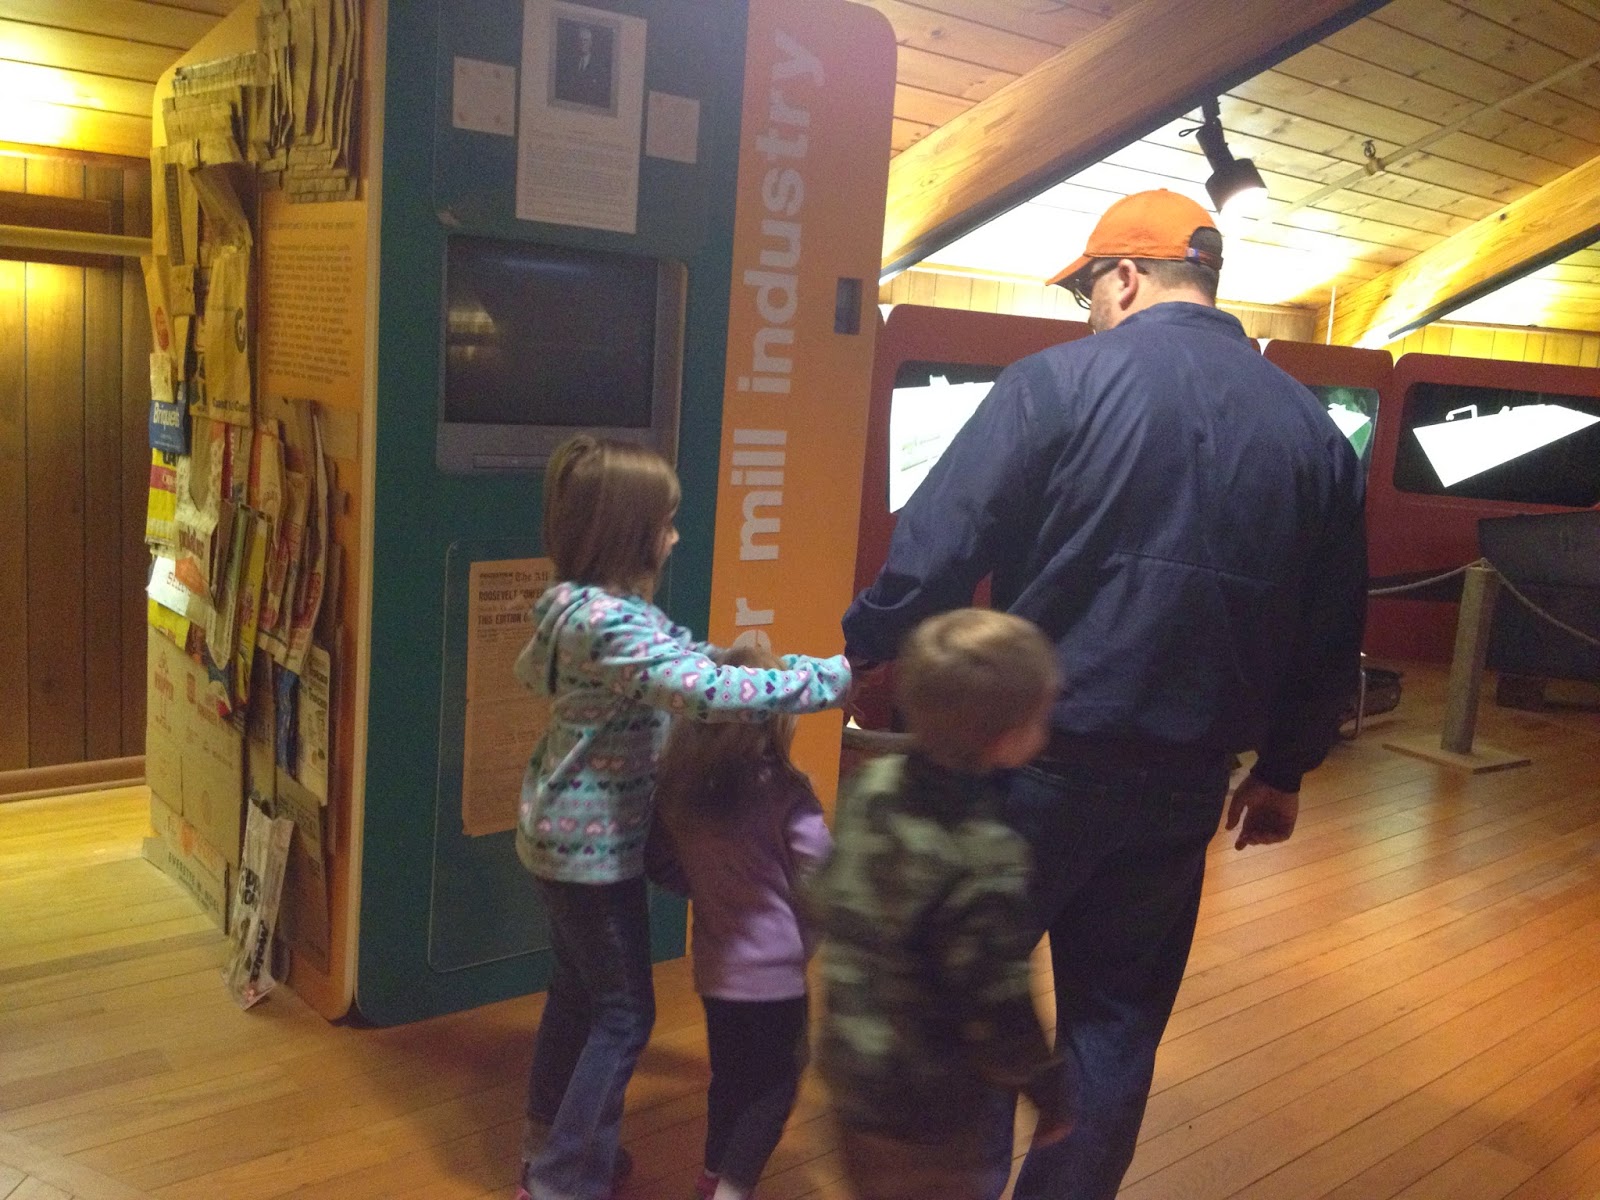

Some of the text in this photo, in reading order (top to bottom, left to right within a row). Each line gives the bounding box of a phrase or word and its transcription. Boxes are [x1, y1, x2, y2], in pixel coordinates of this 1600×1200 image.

[731, 28, 825, 657] er mill industry
